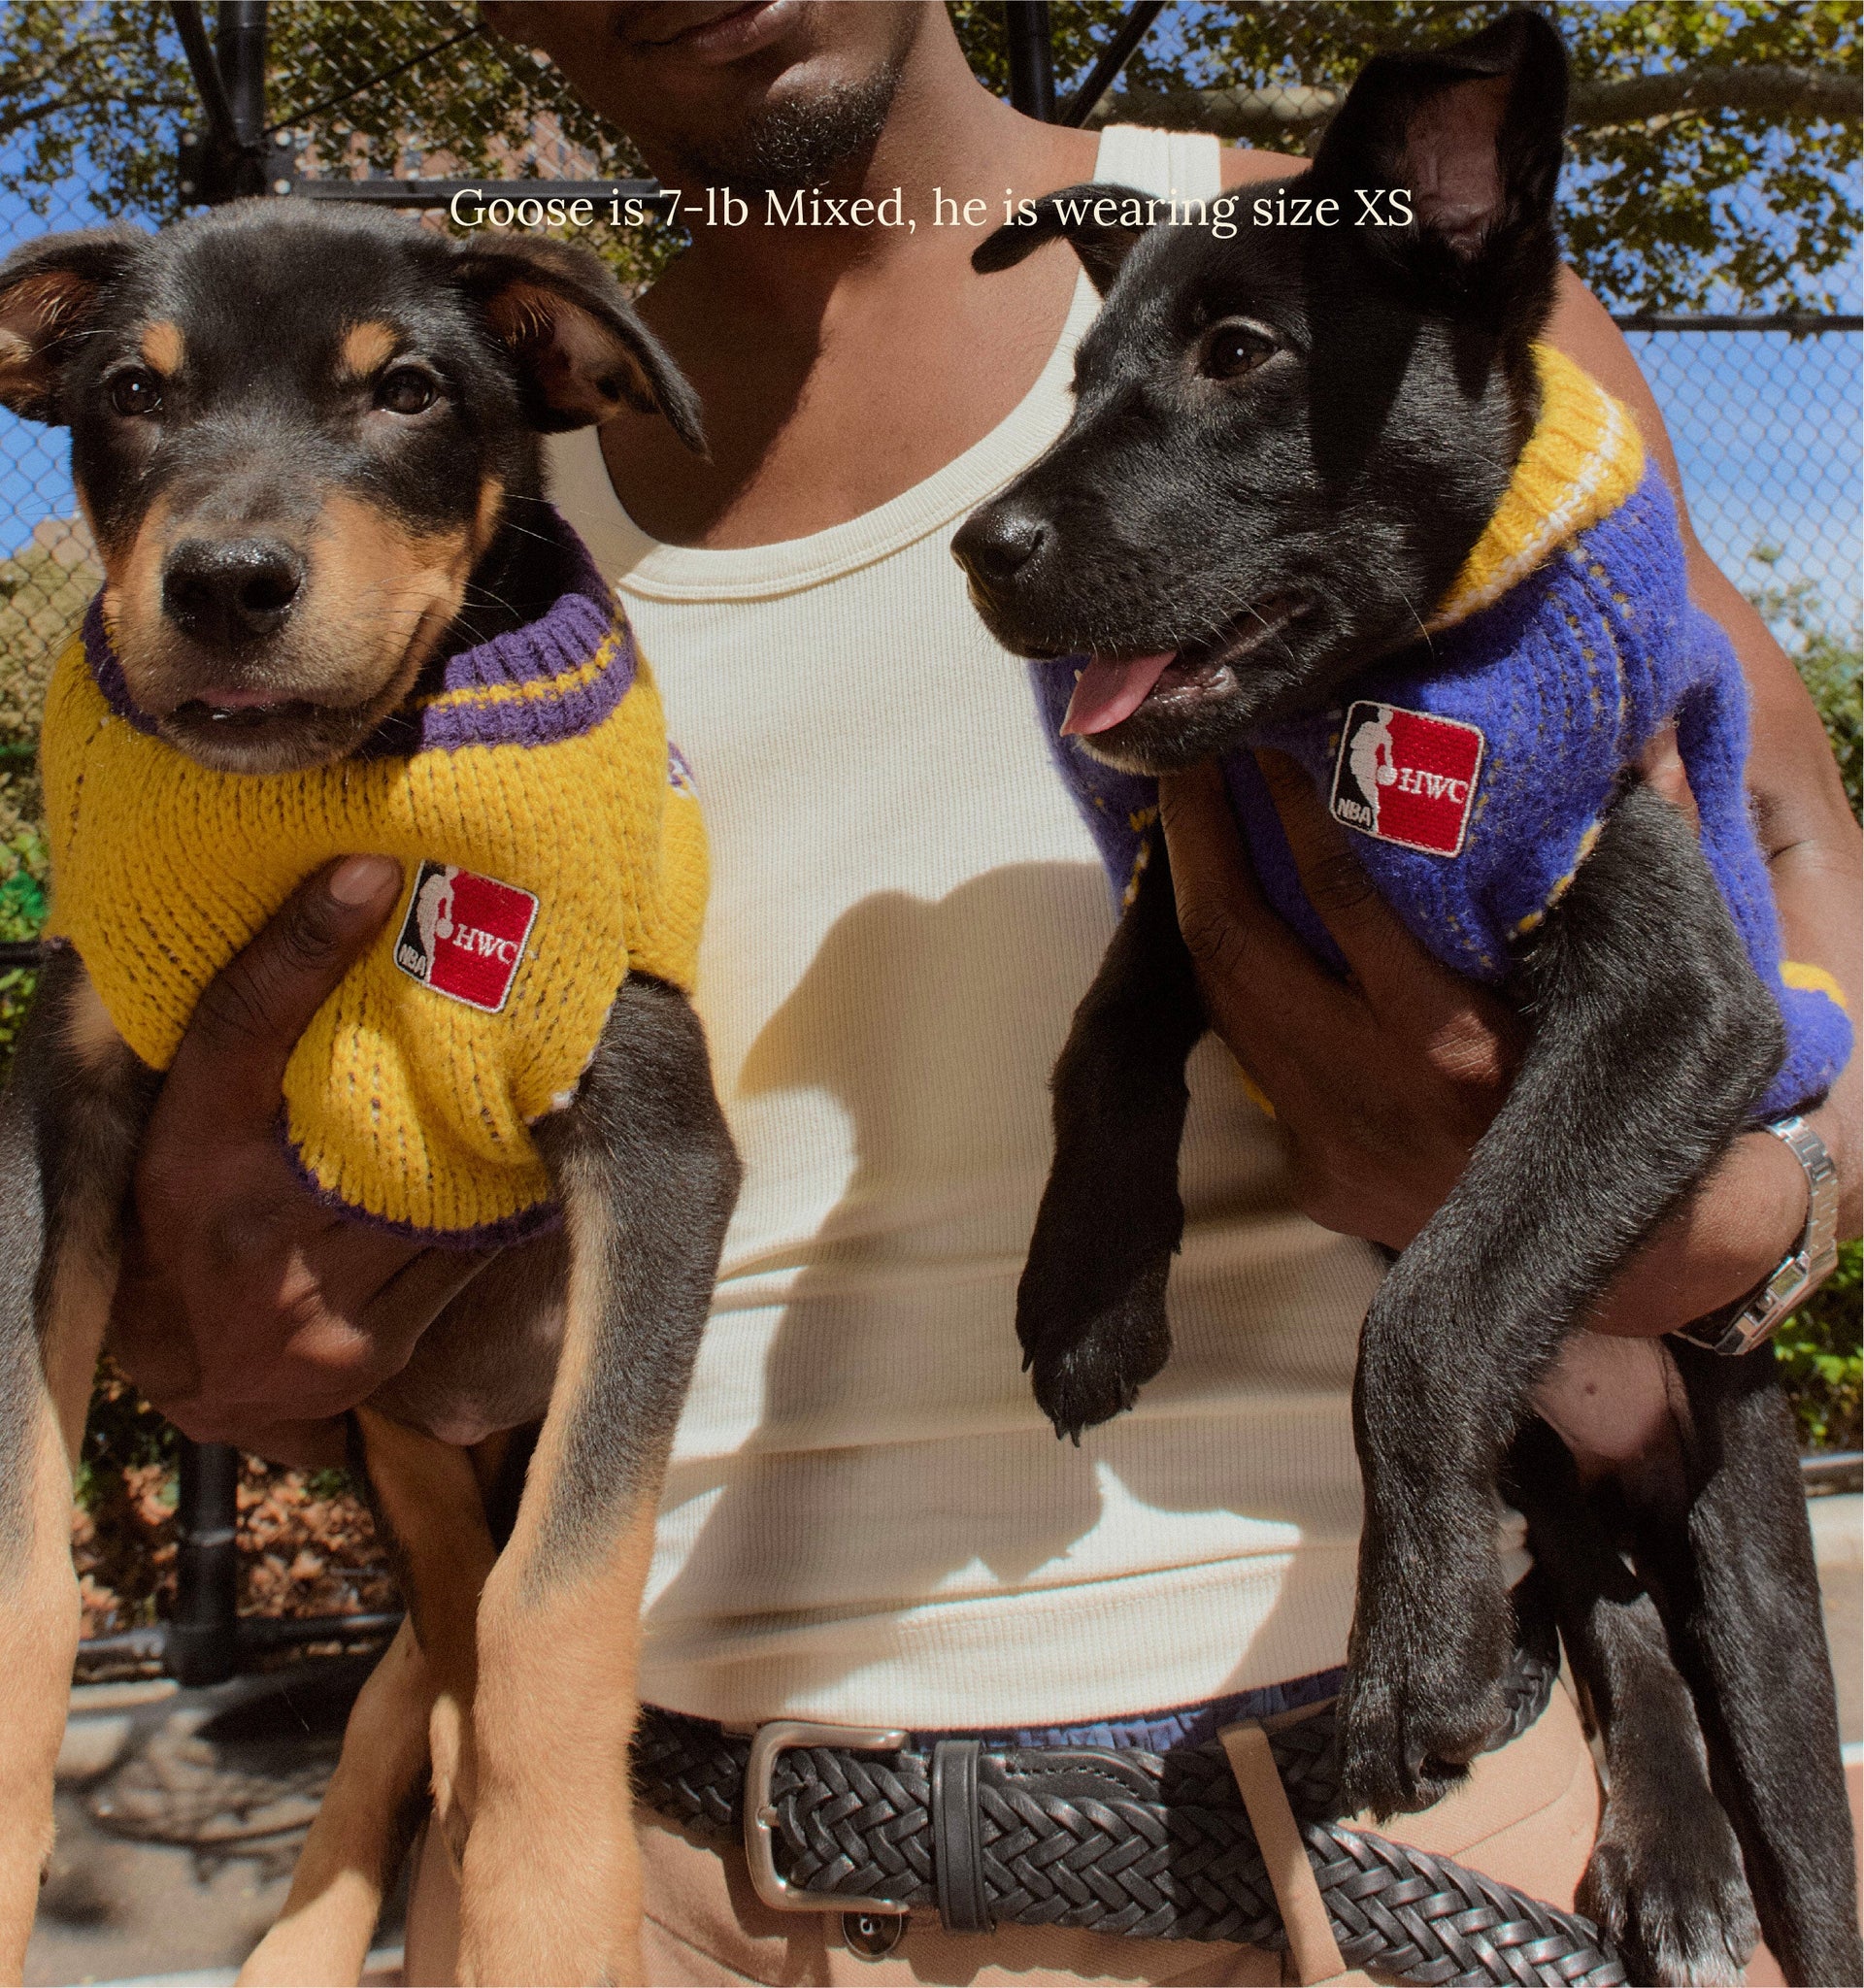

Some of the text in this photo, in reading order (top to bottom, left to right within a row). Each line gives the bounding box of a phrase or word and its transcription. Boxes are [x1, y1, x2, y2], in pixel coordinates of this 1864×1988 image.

[1397, 767, 1469, 805] HWC
[1337, 798, 1373, 827] NBA
[398, 944, 427, 977] NBA
[452, 923, 518, 965] HWC
